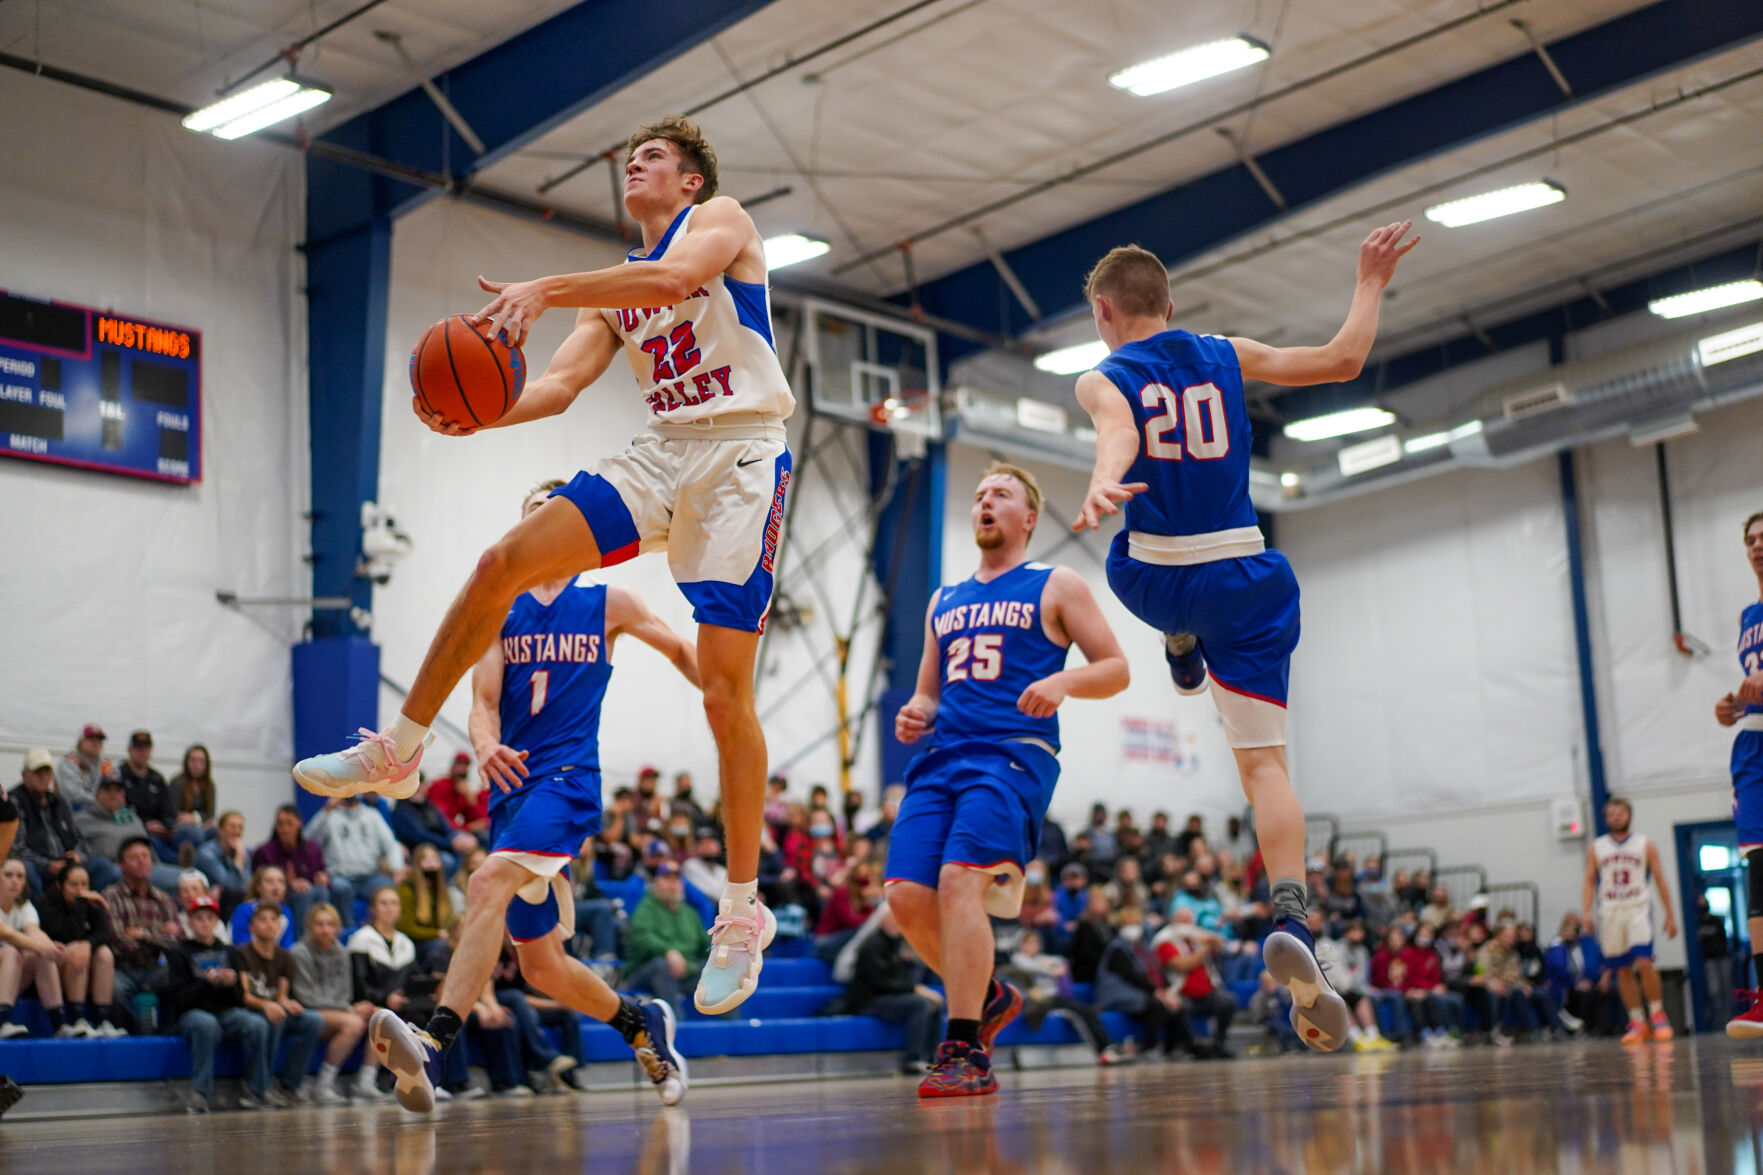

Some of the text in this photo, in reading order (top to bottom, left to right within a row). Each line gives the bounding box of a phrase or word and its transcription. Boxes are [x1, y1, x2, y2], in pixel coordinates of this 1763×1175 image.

[98, 317, 190, 359] MUSTANGS
[640, 320, 702, 385] 22
[0, 384, 67, 411] LAYER FOUL
[9, 433, 48, 455] MATCH
[1139, 381, 1230, 462] 20
[946, 633, 1004, 684] 25
[529, 669, 550, 716] 1
